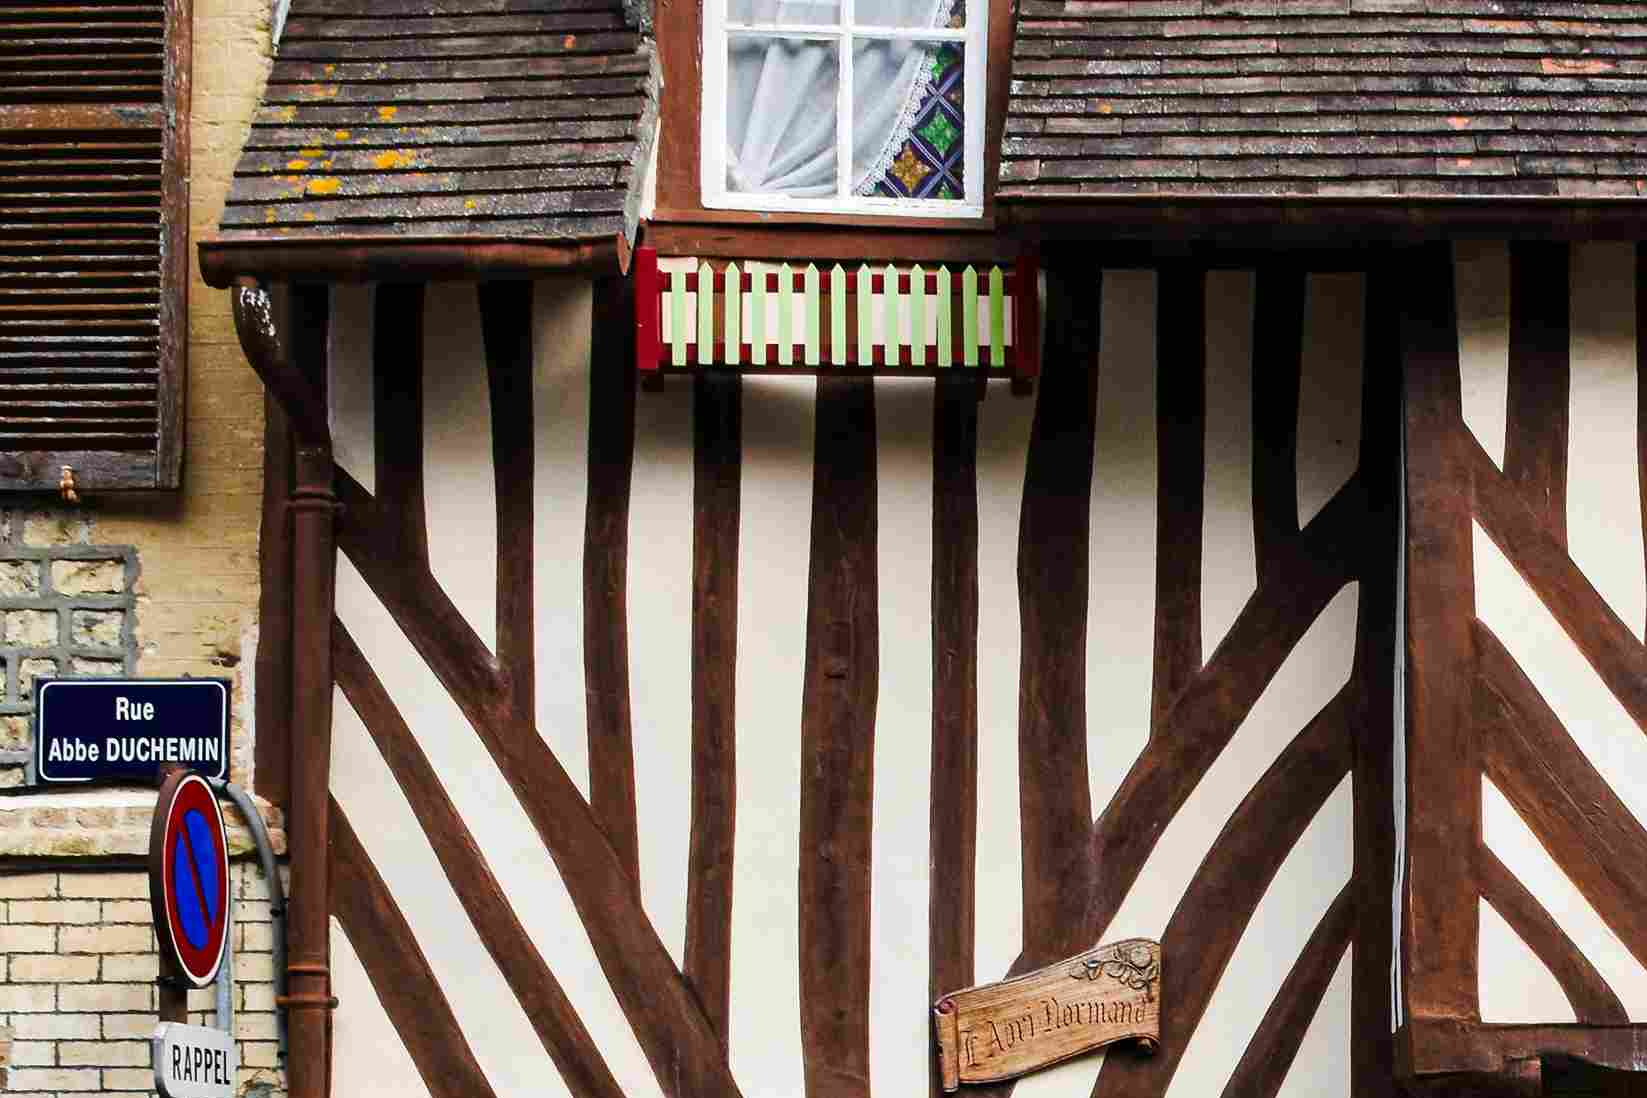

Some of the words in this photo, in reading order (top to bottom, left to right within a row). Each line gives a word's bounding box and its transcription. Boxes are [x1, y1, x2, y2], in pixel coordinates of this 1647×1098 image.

[115, 696, 155, 721] Rue
[48, 737, 100, 762] Abbe
[105, 737, 219, 762] DUCHEMIN
[172, 1044, 231, 1085] RAPPEL
